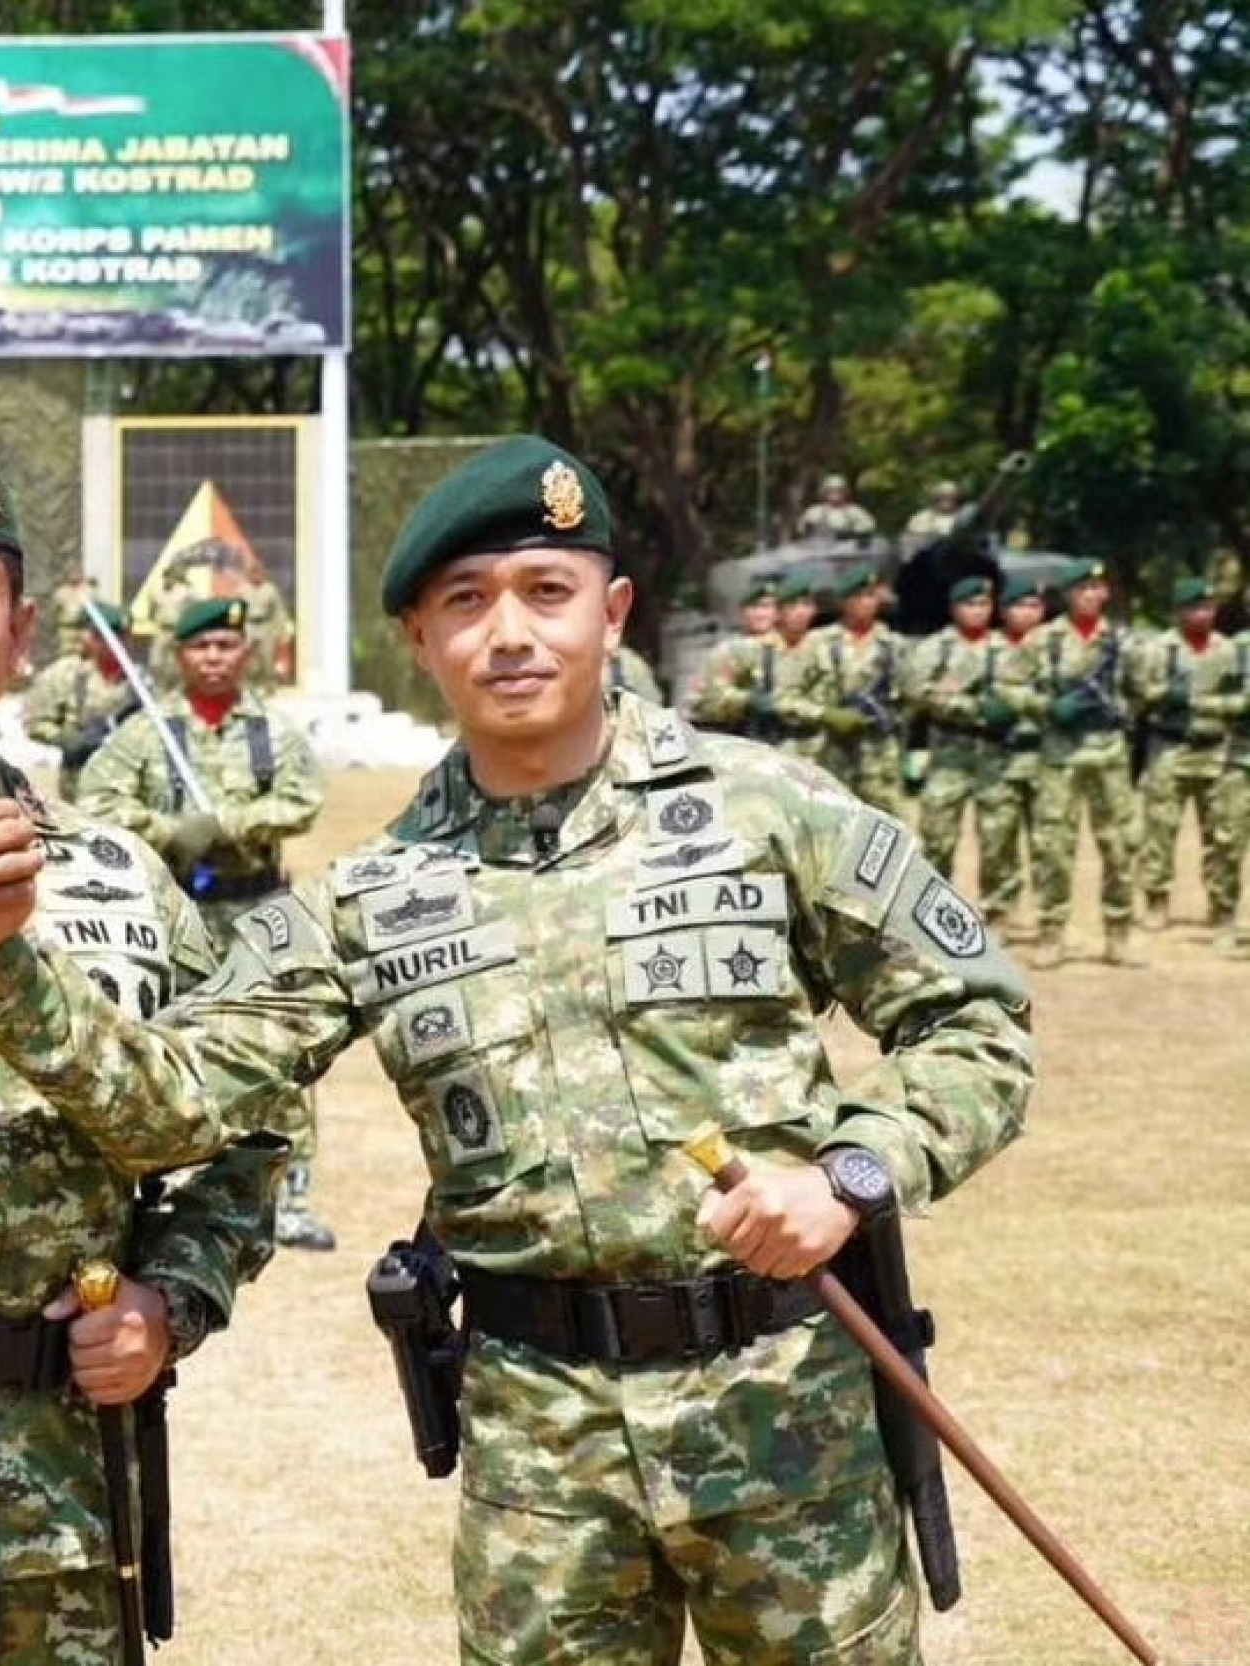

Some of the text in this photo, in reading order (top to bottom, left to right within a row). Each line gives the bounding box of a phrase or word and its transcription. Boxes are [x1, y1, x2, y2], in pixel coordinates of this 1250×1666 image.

[116, 134, 288, 161] JABATAN
[73, 164, 255, 193] KOSTRAD
[3, 226, 133, 253] KORPS
[141, 223, 274, 252] PAMEN
[21, 256, 203, 283] KOSTRAD
[630, 883, 763, 923] TNI AD
[54, 918, 158, 951] TNI AD
[374, 939, 482, 991] NURIL
